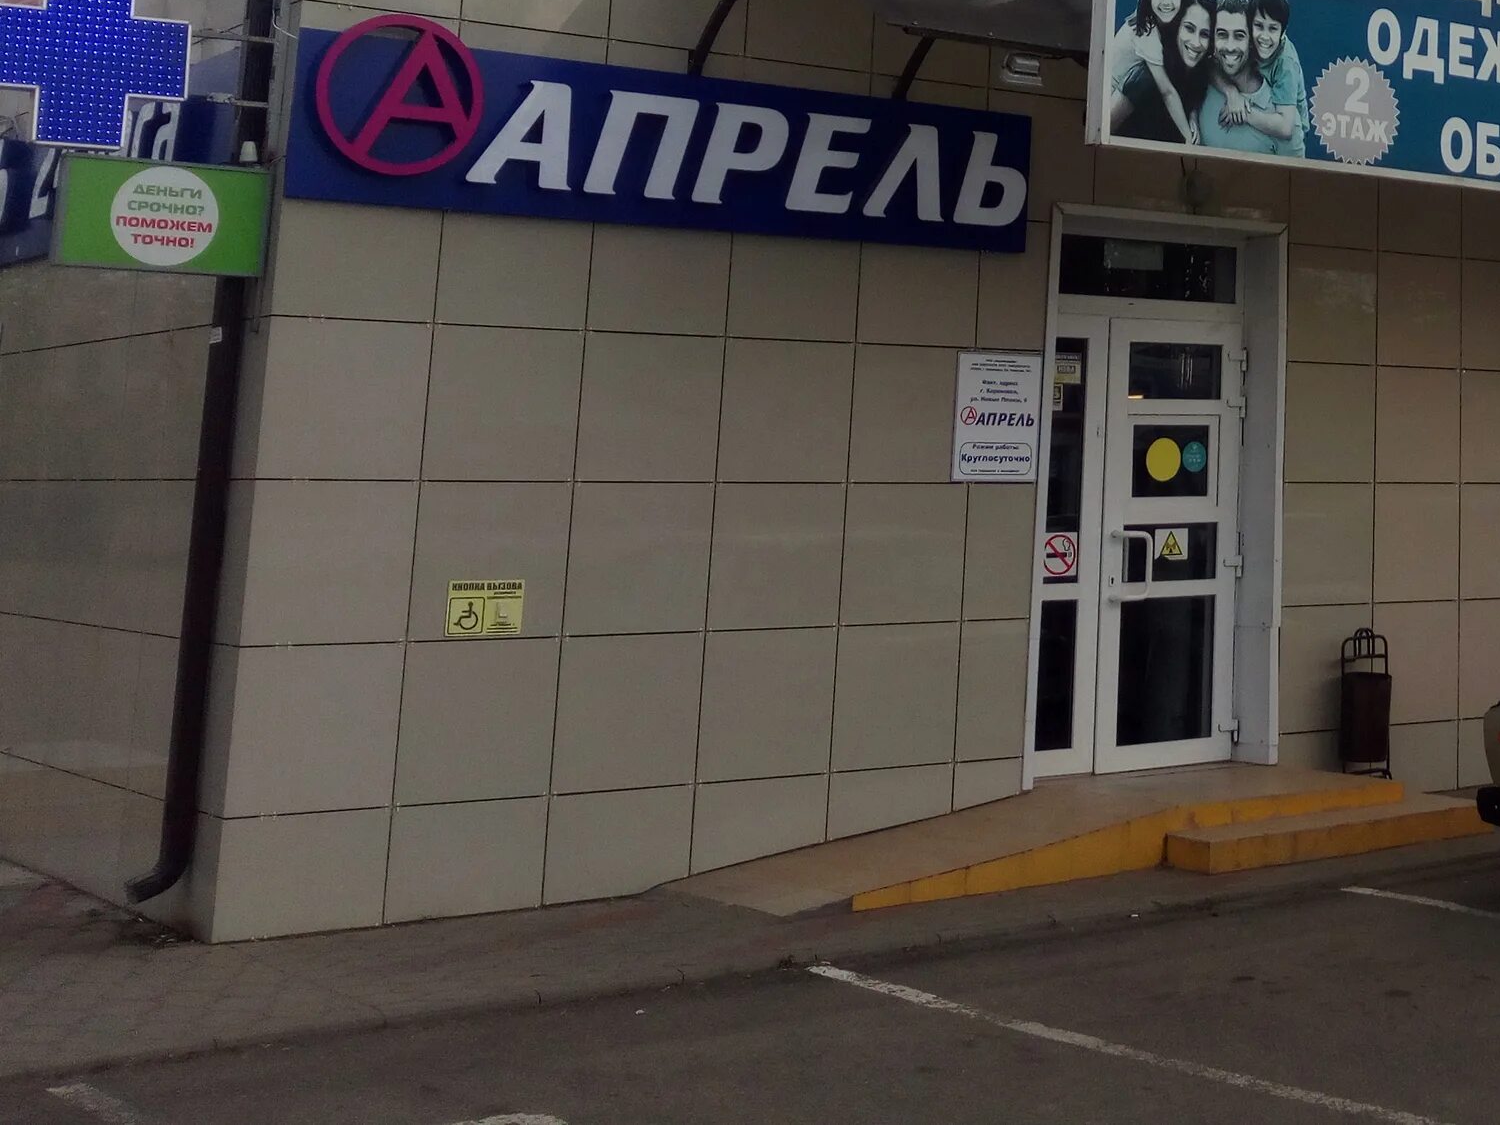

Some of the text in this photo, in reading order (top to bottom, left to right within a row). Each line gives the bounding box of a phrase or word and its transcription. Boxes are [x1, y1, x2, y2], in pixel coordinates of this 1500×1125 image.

[1344, 67, 1371, 114] 2
[1320, 111, 1390, 146] ЭТАЖ
[466, 80, 1027, 227] АПРЕЛЬ
[133, 183, 202, 199] ДЕНЬГИ
[127, 200, 205, 216] СРОЧНО?
[115, 215, 213, 234] ПОМОЖЕМ
[131, 233, 195, 248] ТОЧНО!
[975, 412, 1035, 427] АПРЕЛЬ
[961, 453, 1031, 464] Круглосуточно
[452, 582, 523, 591] КНОПКА ВЫЗОВА
